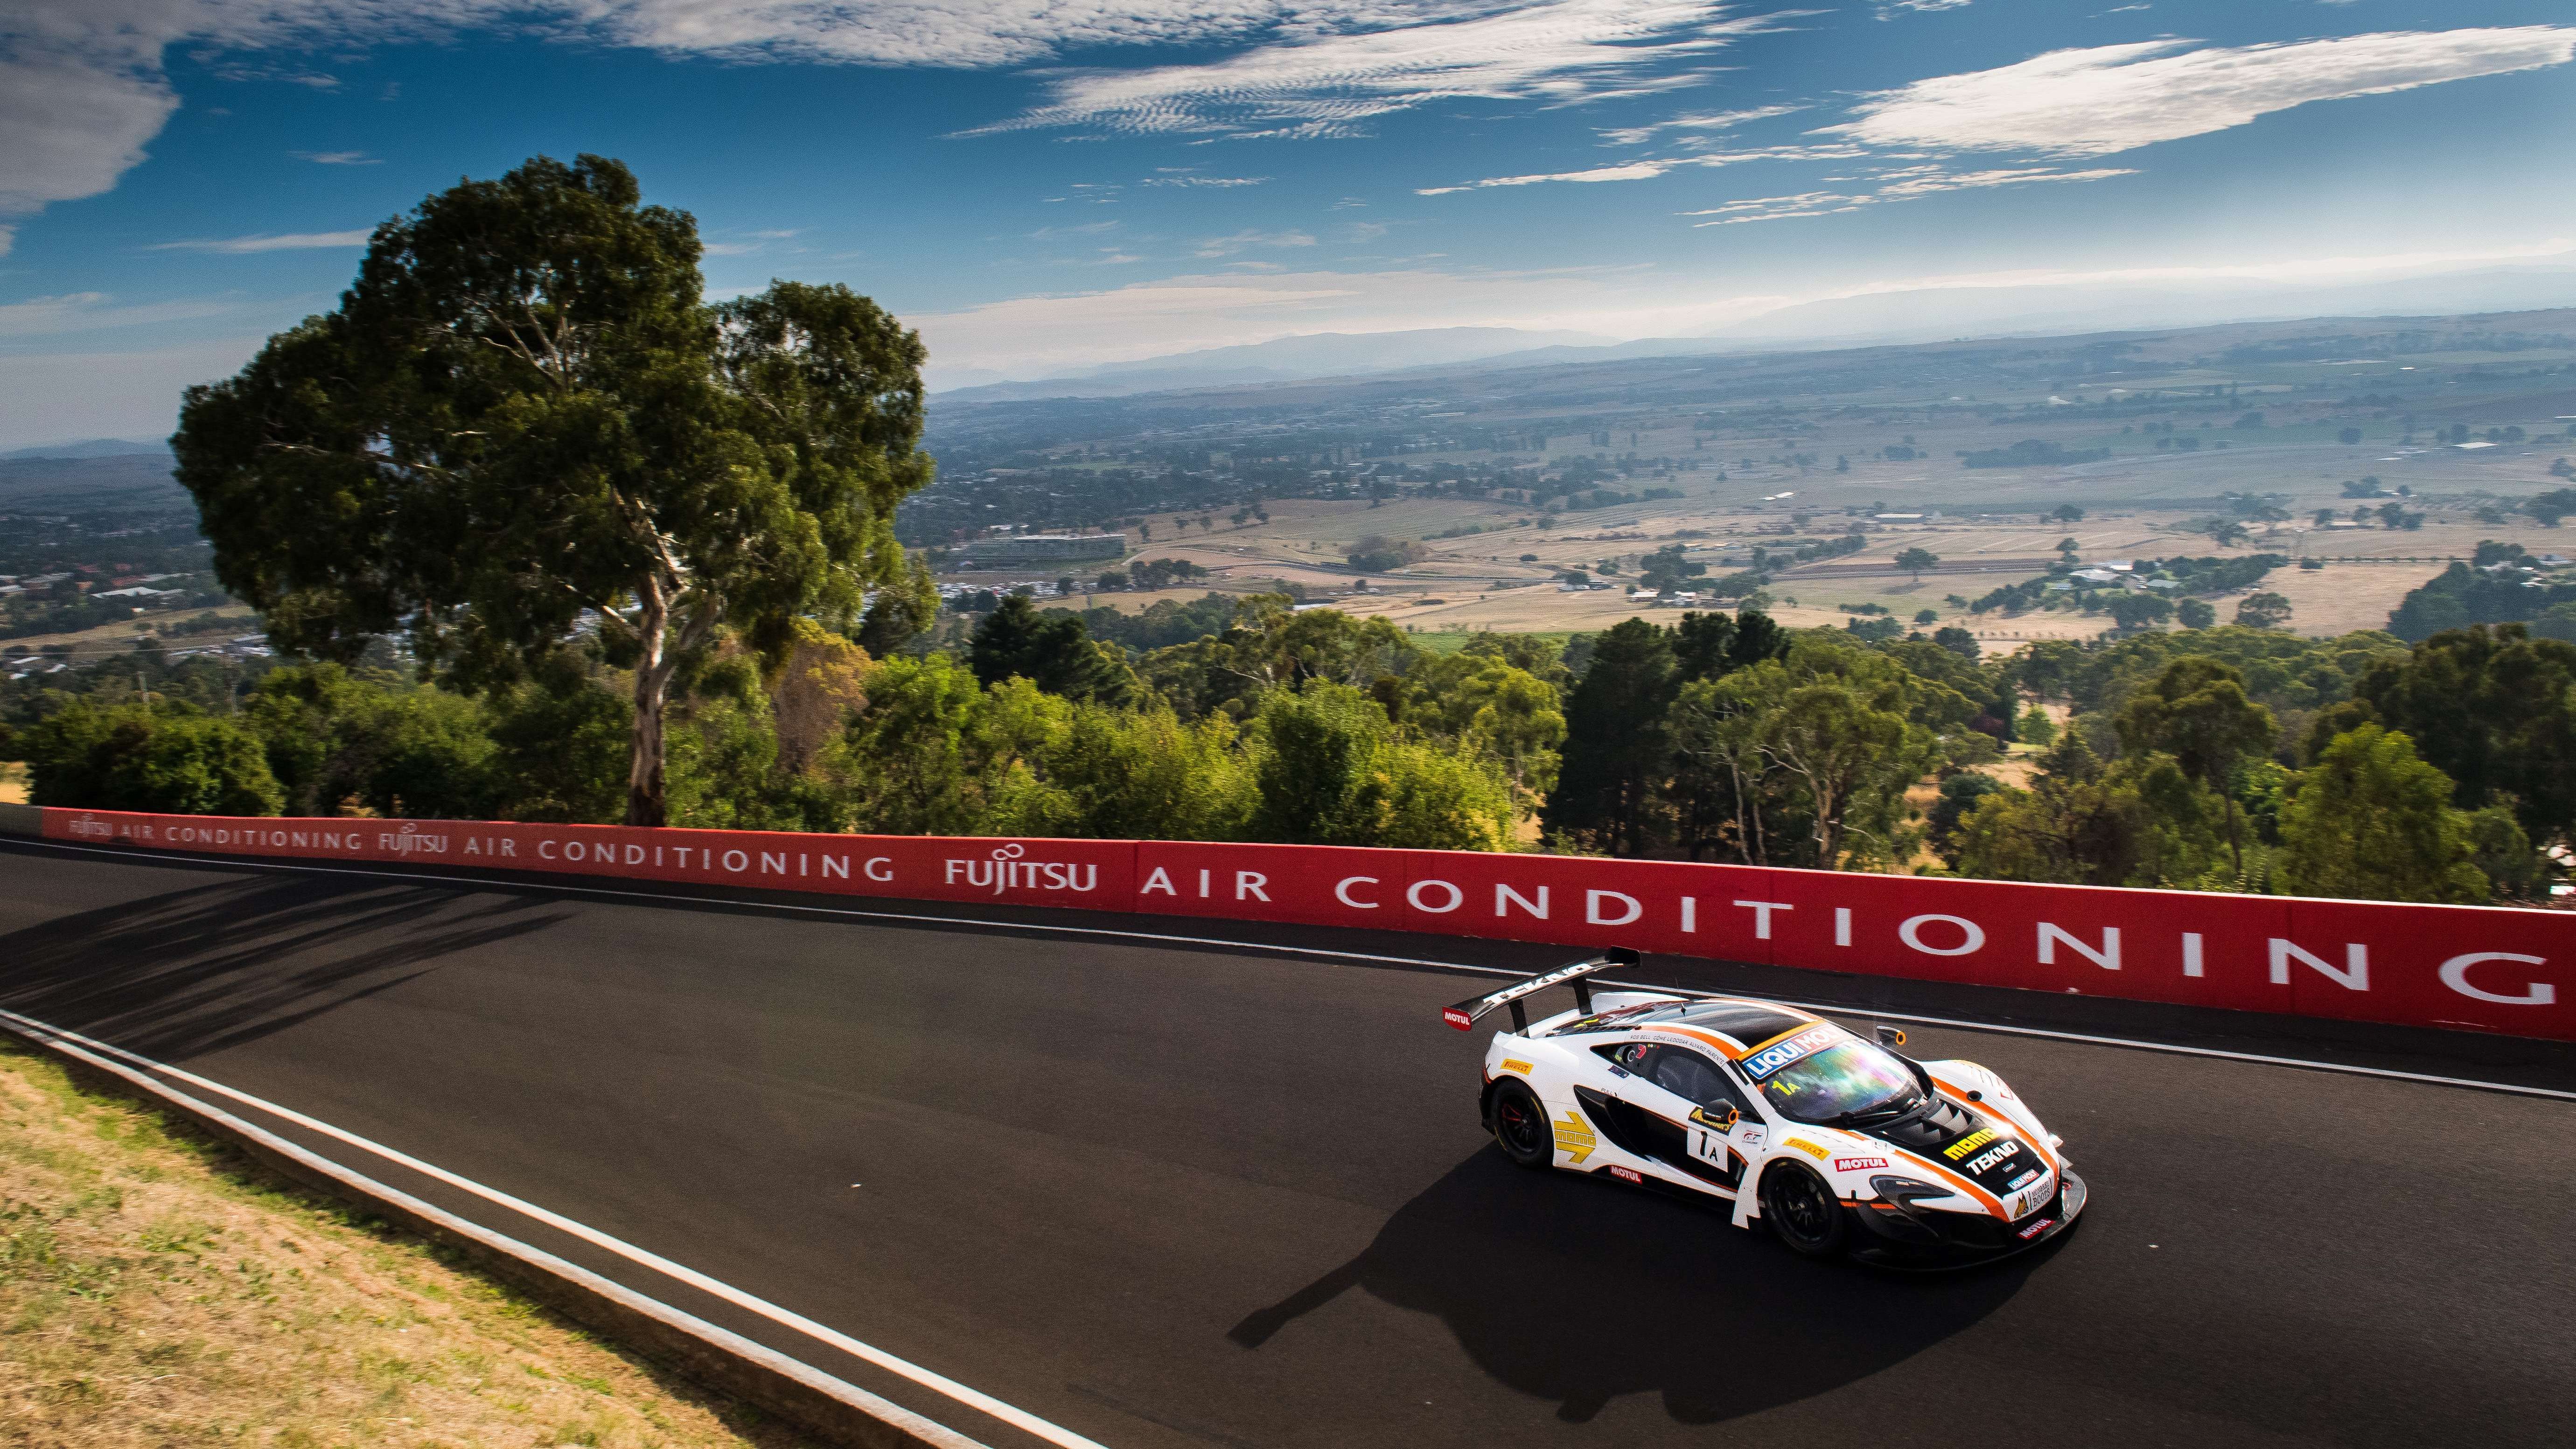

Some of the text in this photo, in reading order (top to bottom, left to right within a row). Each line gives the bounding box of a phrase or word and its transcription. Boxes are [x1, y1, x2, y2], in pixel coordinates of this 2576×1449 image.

[120, 824, 154, 839] AIR
[165, 826, 362, 850] CONDITIONING
[378, 823, 894, 882] FUJITSU AIR CONDITIONING
[945, 843, 2555, 1005] FUJITSU AIR CONDITIONING
[1483, 963, 1593, 1004] TEKNO
[1445, 1012, 1469, 1025] MOTUL
[1504, 1060, 1529, 1072] PIRELLI
[1706, 1049, 1724, 1065] PARENTE
[1746, 1042, 1806, 1075] LIQUI
[1601, 1087, 1613, 1096] PULL
[1789, 1139, 1824, 1156] PIRELLI
[1839, 1159, 1886, 1170] MOTUL
[1965, 1141, 2020, 1176] TEKNO
[1612, 1166, 1641, 1182] MOTUL
[2009, 1170, 2038, 1190] LIQUI MOLY
[2033, 1188, 2050, 1207] BOOTS
[2019, 1218, 2051, 1237] MOTUL
